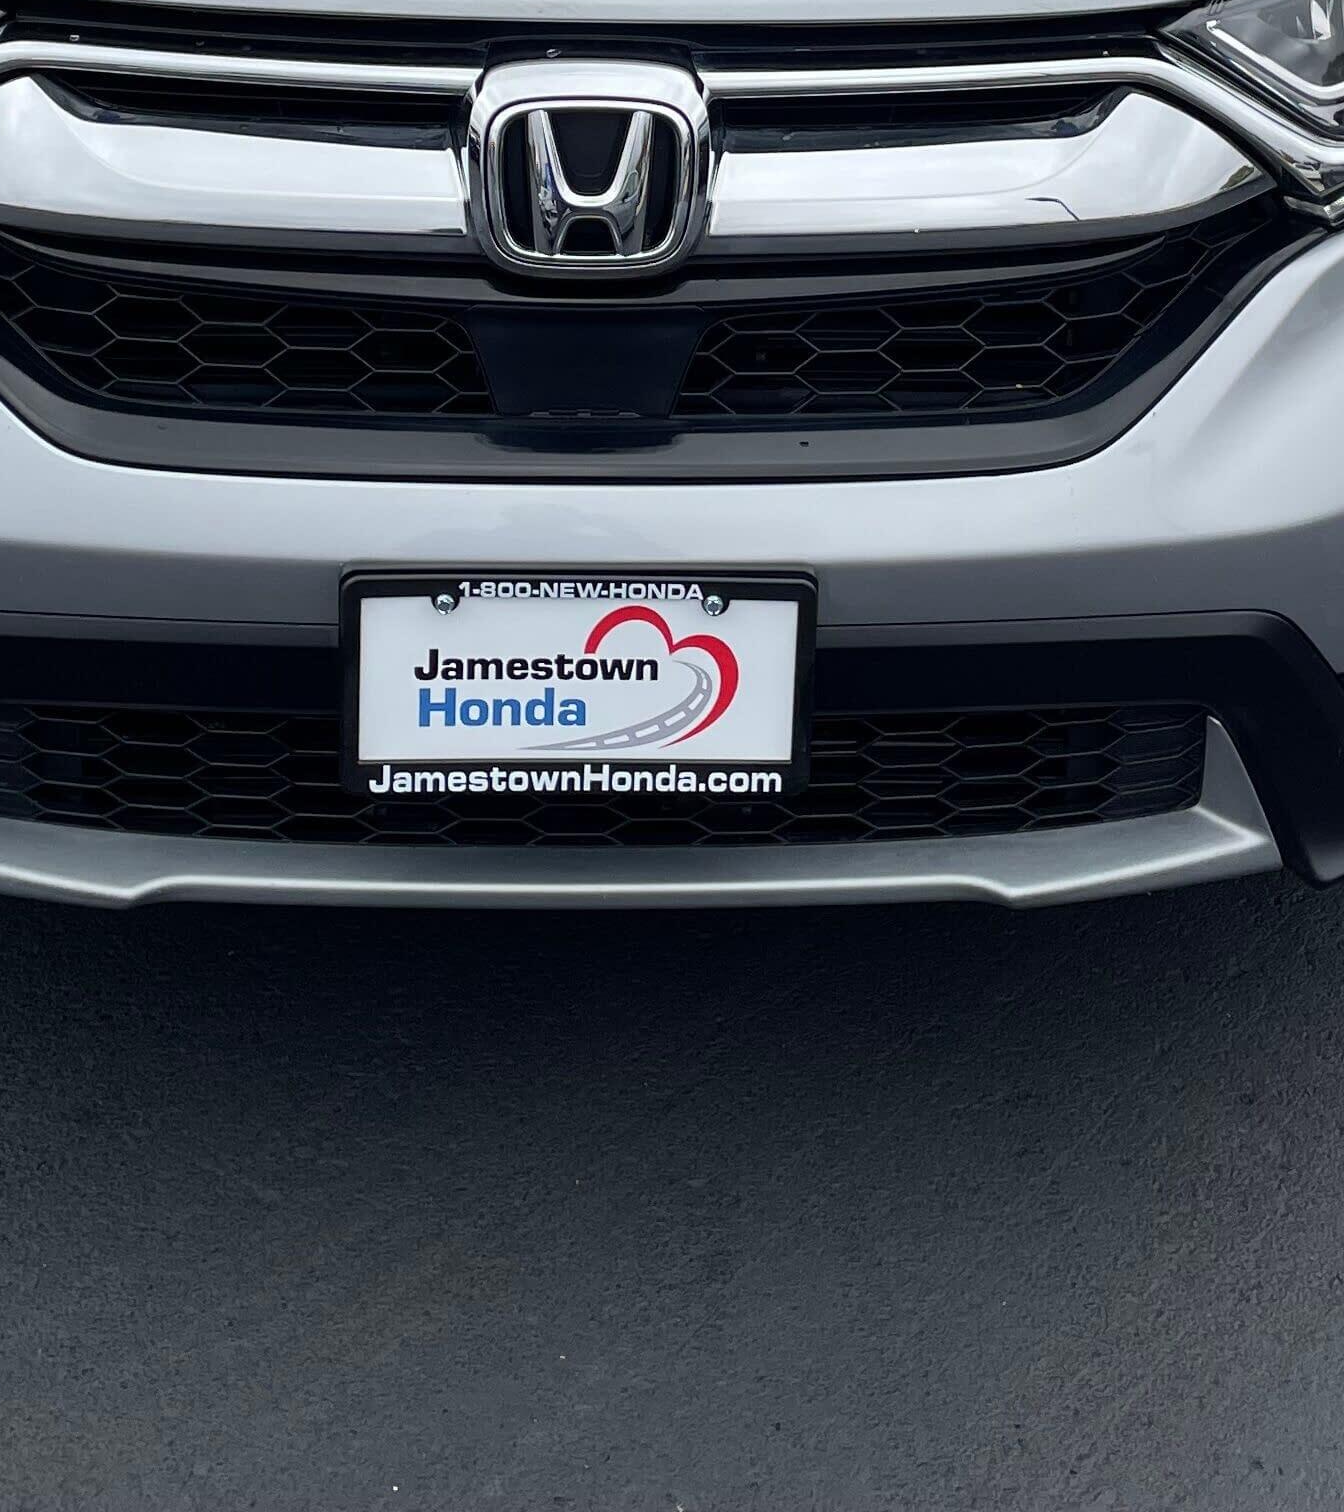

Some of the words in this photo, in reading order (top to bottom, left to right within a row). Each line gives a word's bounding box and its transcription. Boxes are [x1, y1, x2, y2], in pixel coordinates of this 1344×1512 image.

[458, 581, 705, 601] 1-800-NEW-HONDA
[414, 648, 659, 682] Jamestown
[418, 688, 587, 727] Honda
[368, 764, 783, 794] JamestownHonda.com
